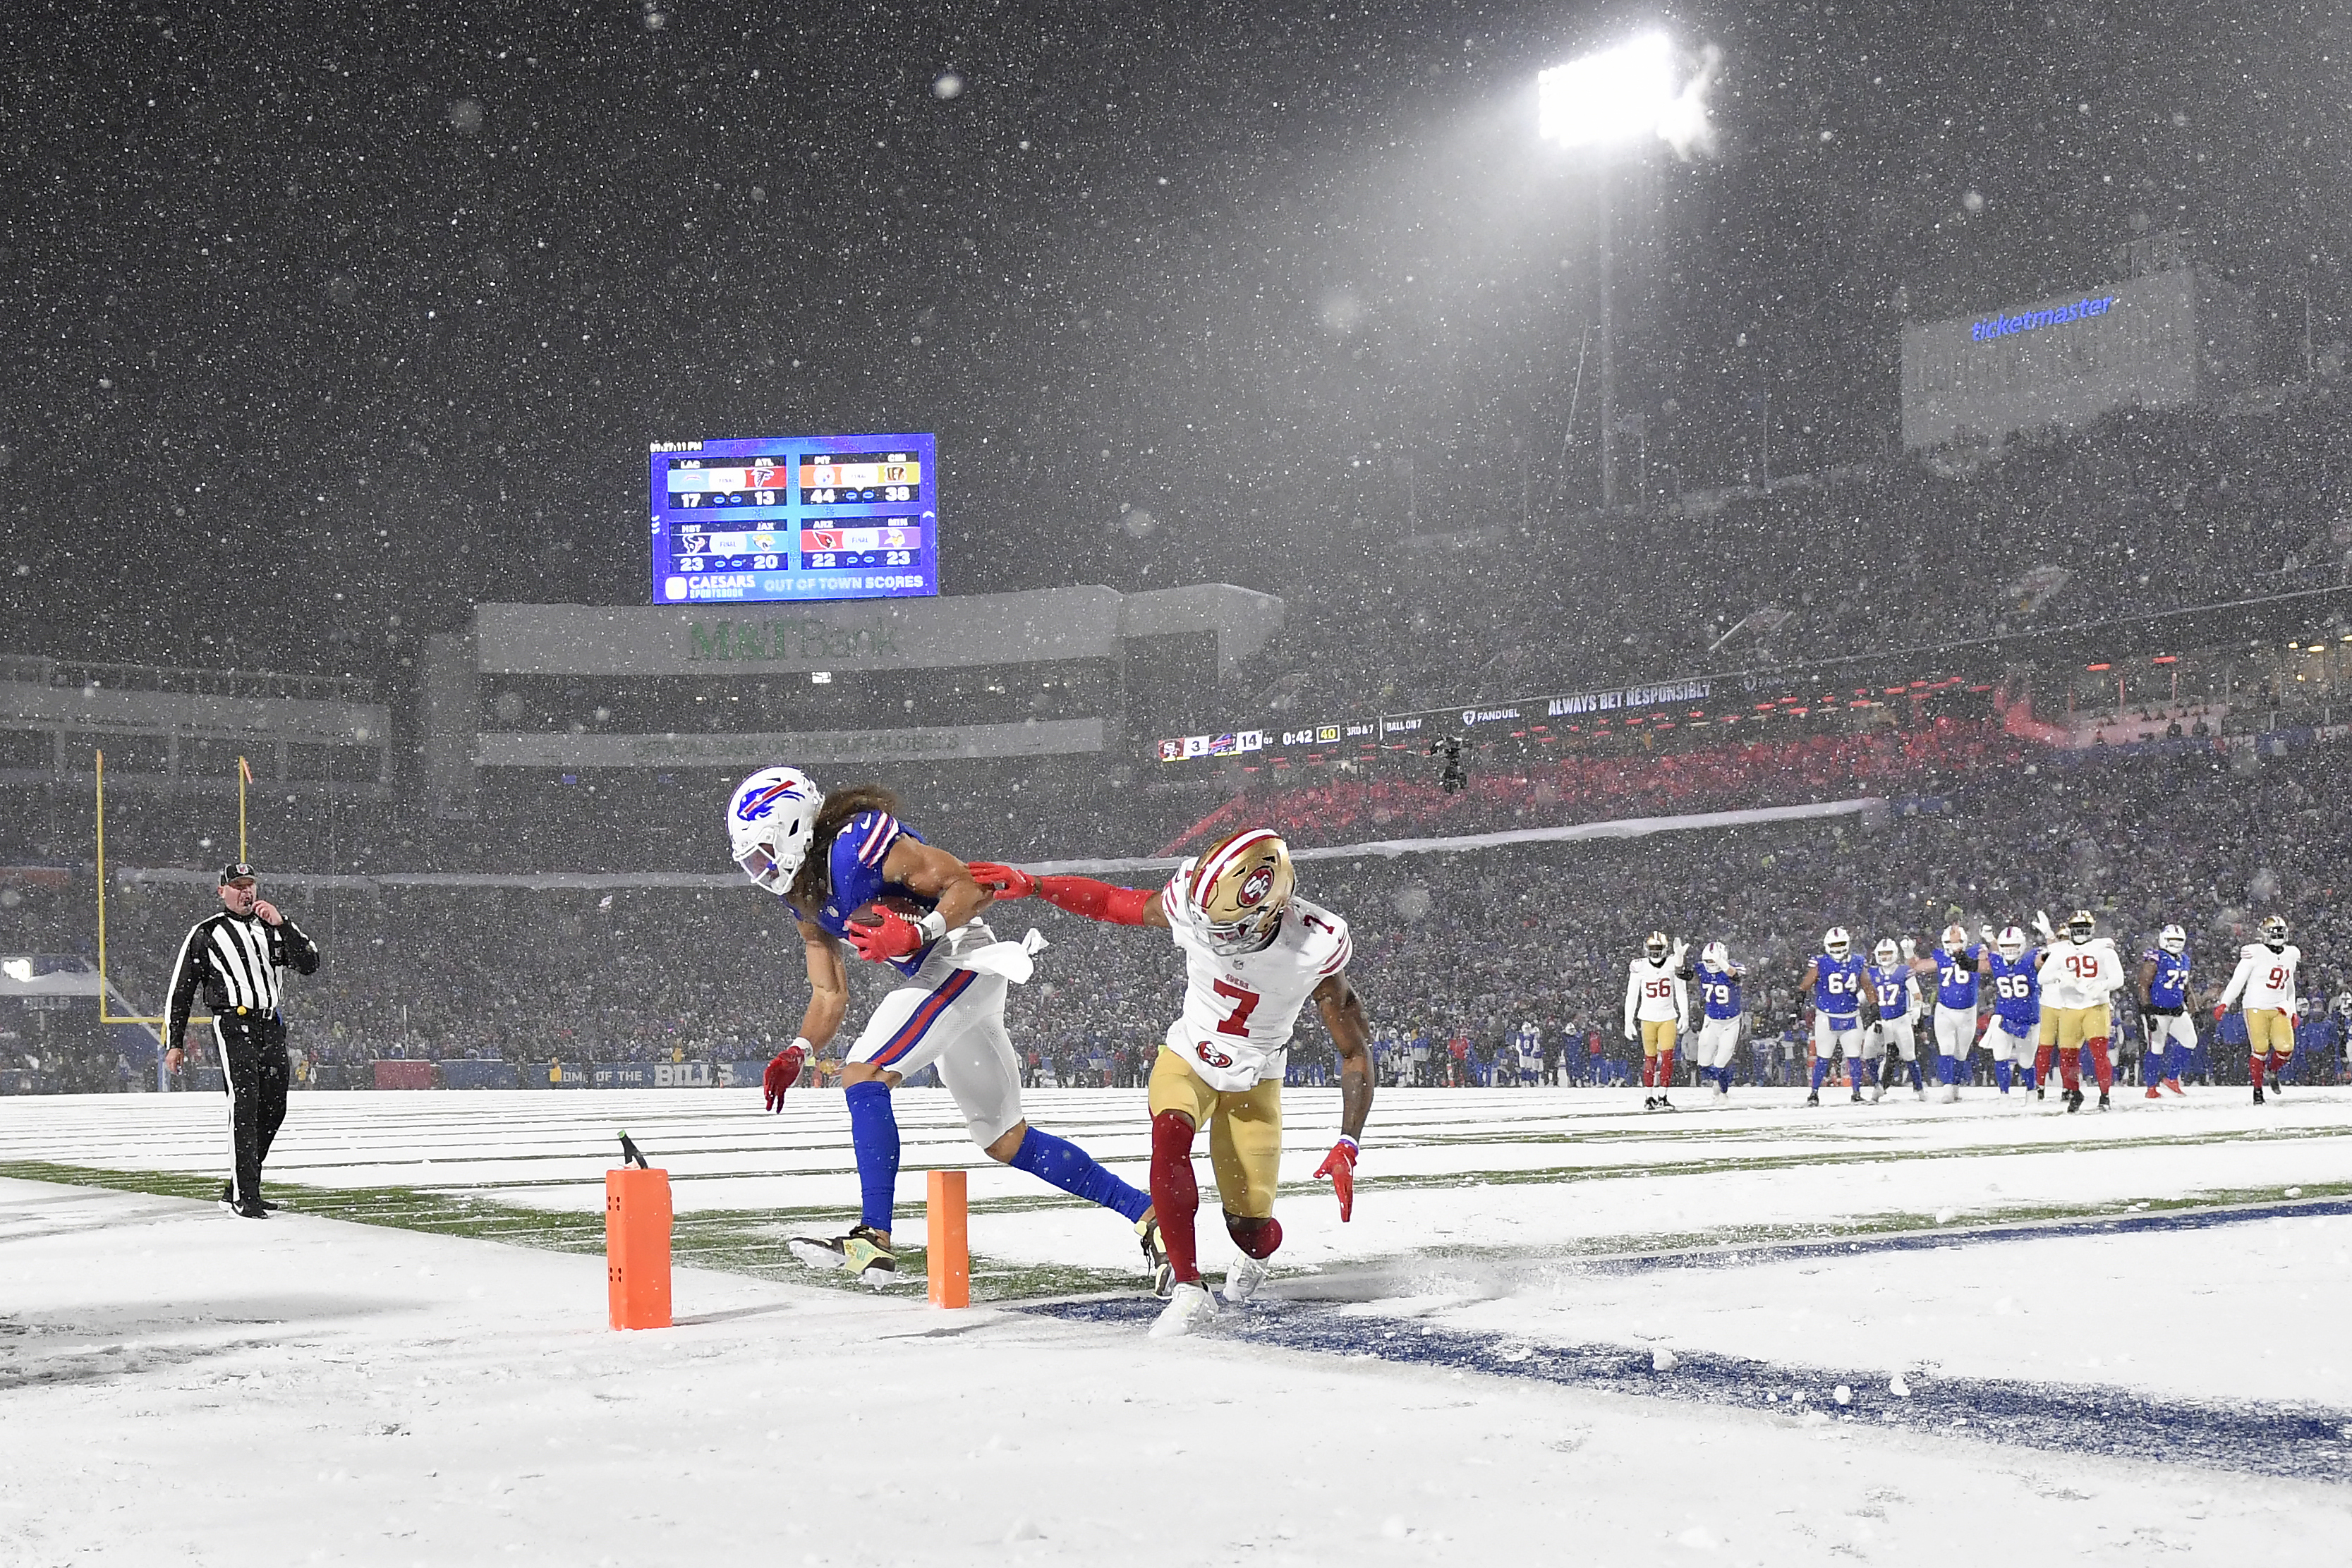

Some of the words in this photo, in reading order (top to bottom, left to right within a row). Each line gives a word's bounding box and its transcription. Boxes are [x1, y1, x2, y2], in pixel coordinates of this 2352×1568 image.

[1972, 296, 2114, 341] ticketmaster
[687, 442, 703, 451] PM
[755, 458, 774, 467] ATL
[681, 493, 701, 507] 17
[755, 490, 775, 505] 13
[811, 488, 835, 504] 44
[885, 487, 910, 501] 38
[888, 518, 908, 526] MIN
[680, 557, 704, 571] 23
[754, 554, 778, 569] 20
[812, 553, 836, 567] 22
[887, 551, 910, 565] 23
[689, 575, 756, 590] CAESARS
[764, 578, 794, 592] OUT
[796, 578, 817, 590] OF
[818, 577, 862, 590] TOWN
[865, 576, 924, 589] SCORES
[689, 588, 744, 599] SPORTSBOOK
[686, 619, 798, 661] M&T
[801, 616, 898, 659] Bank
[1548, 694, 1596, 716] ALWAYS
[1599, 691, 1623, 711] BET
[1625, 683, 1711, 707] RESPONSIBLY
[1477, 708, 1520, 722] FANDUEL
[1347, 727, 1362, 736] 3RD
[1369, 724, 1374, 734] 7
[1386, 722, 1405, 732] BALL
[1417, 719, 1422, 729] 7
[1242, 734, 1257, 748] 14
[1283, 729, 1313, 745] 0:42
[1321, 729, 1336, 739] 40
[1191, 741, 1201, 752] 3
[1302, 913, 1335, 935] 7
[1225, 973, 1249, 990] 49ERS
[1828, 972, 1857, 994] 64
[1940, 964, 1970, 987] 76
[2265, 967, 2290, 990] 91
[1645, 977, 1671, 999] 56
[1702, 983, 1729, 1004] 79
[1996, 974, 2030, 999] 66
[1877, 983, 1900, 1007] 17
[1213, 977, 1261, 1038] 7
[564, 1071, 587, 1083] OM
[596, 1071, 612, 1081] OF
[618, 1070, 643, 1081] THE
[653, 1064, 734, 1086] BILLS
